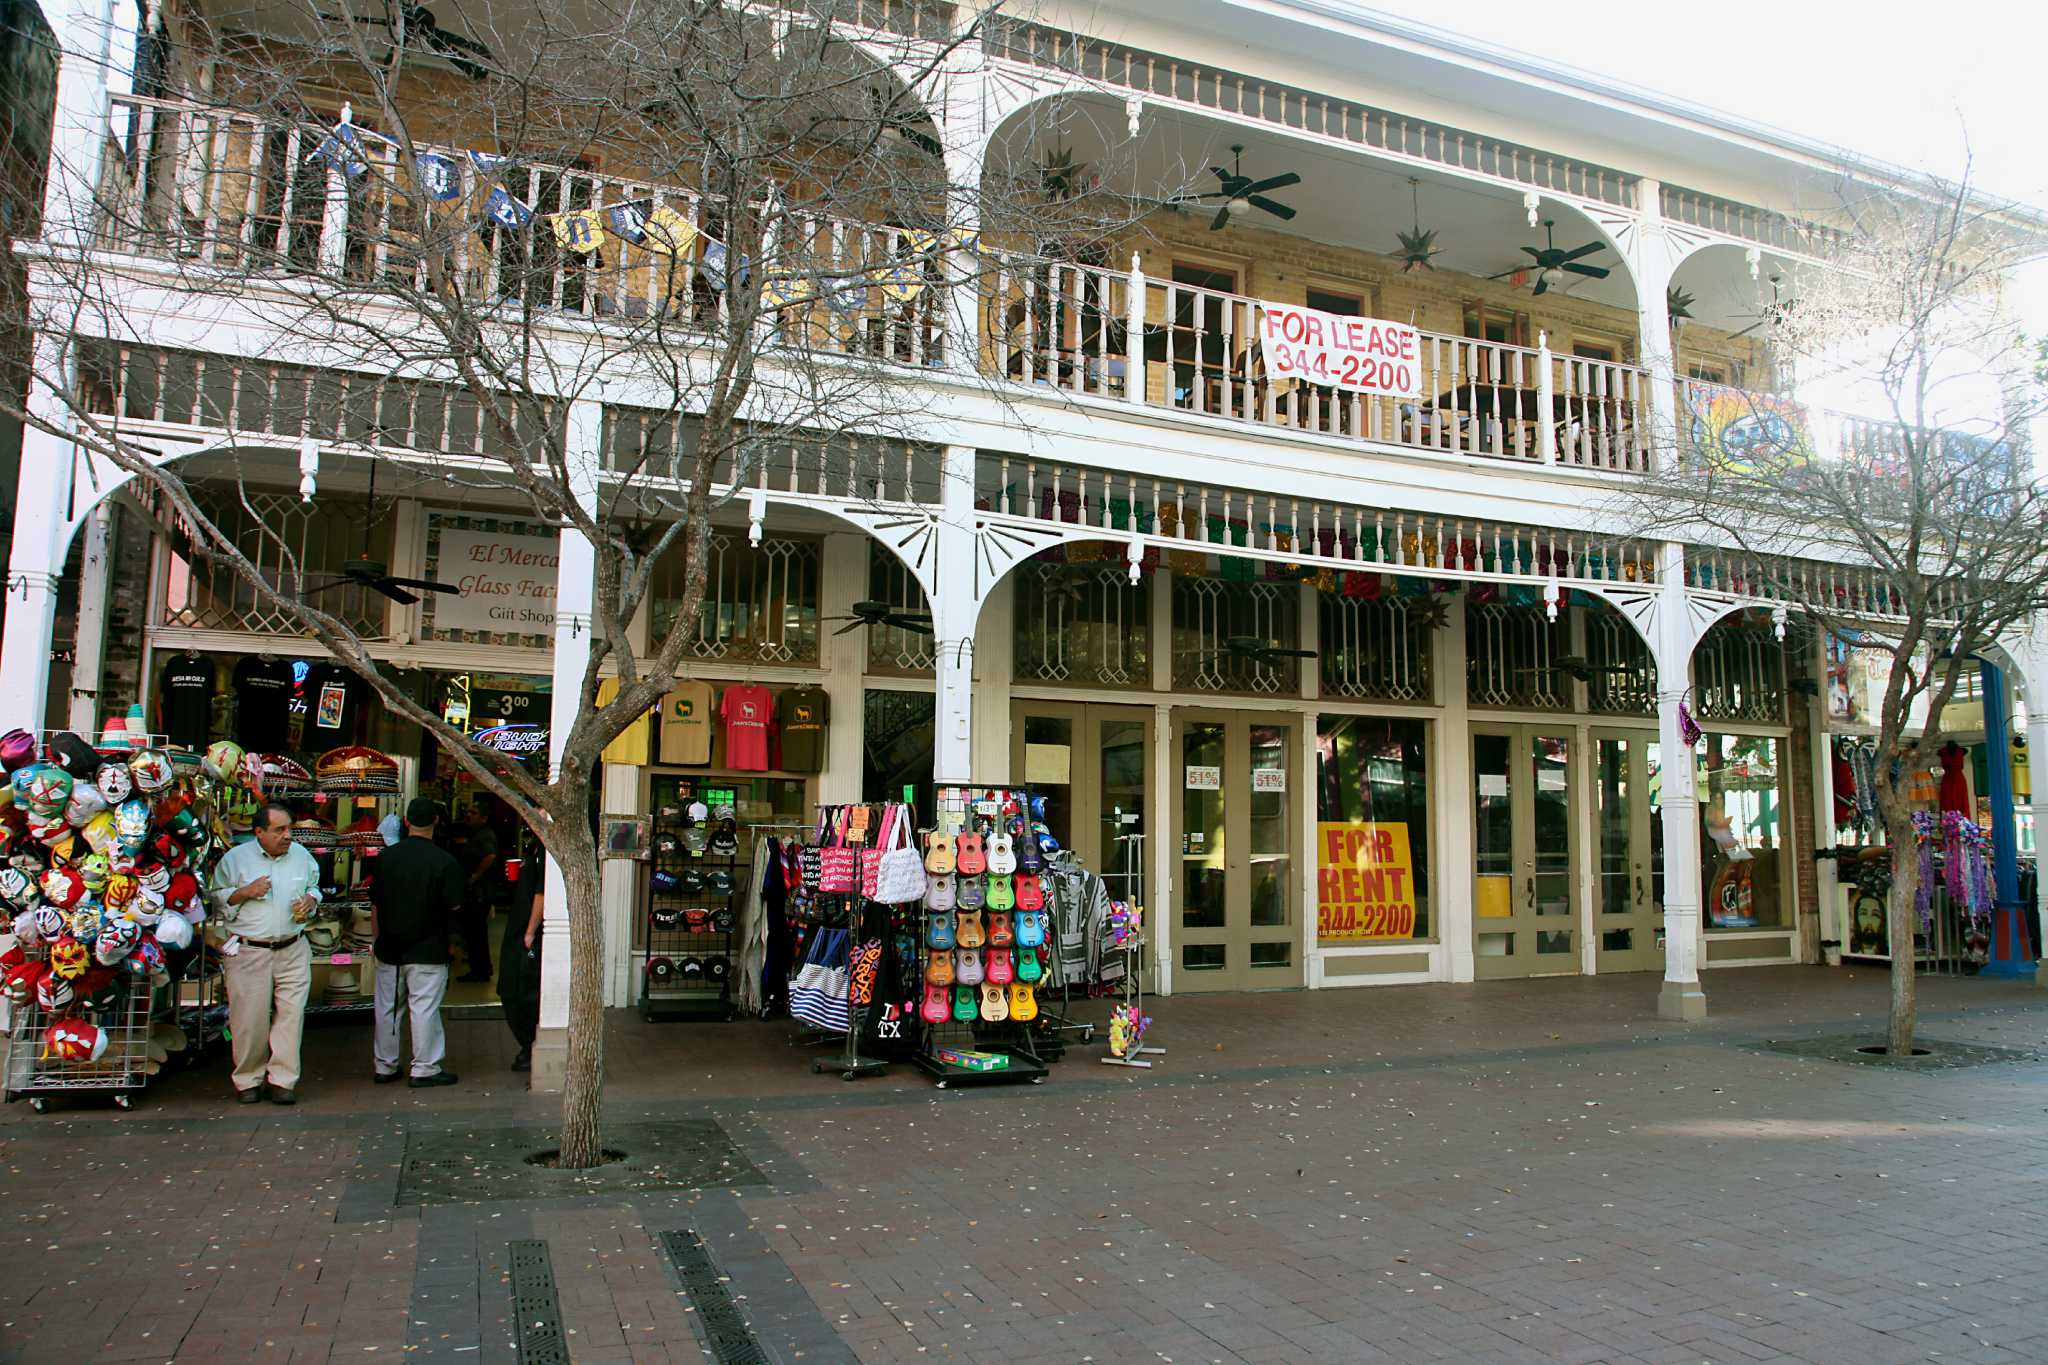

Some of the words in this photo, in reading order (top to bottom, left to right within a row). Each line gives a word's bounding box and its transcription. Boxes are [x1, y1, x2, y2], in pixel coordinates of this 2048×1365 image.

[1266, 309, 1324, 347] FOR
[1331, 321, 1415, 361] LEASE
[1275, 343, 1411, 393] 344-2200
[469, 543, 499, 563] El
[458, 574, 511, 598] Glass
[489, 606, 514, 620] Gift
[519, 609, 554, 625] Shop
[1189, 771, 1217, 785] 51%
[1327, 829, 1395, 863] FOR
[1318, 868, 1406, 903] RENT
[1318, 904, 1412, 936] 344-2200
[878, 1020, 901, 1038] TX
